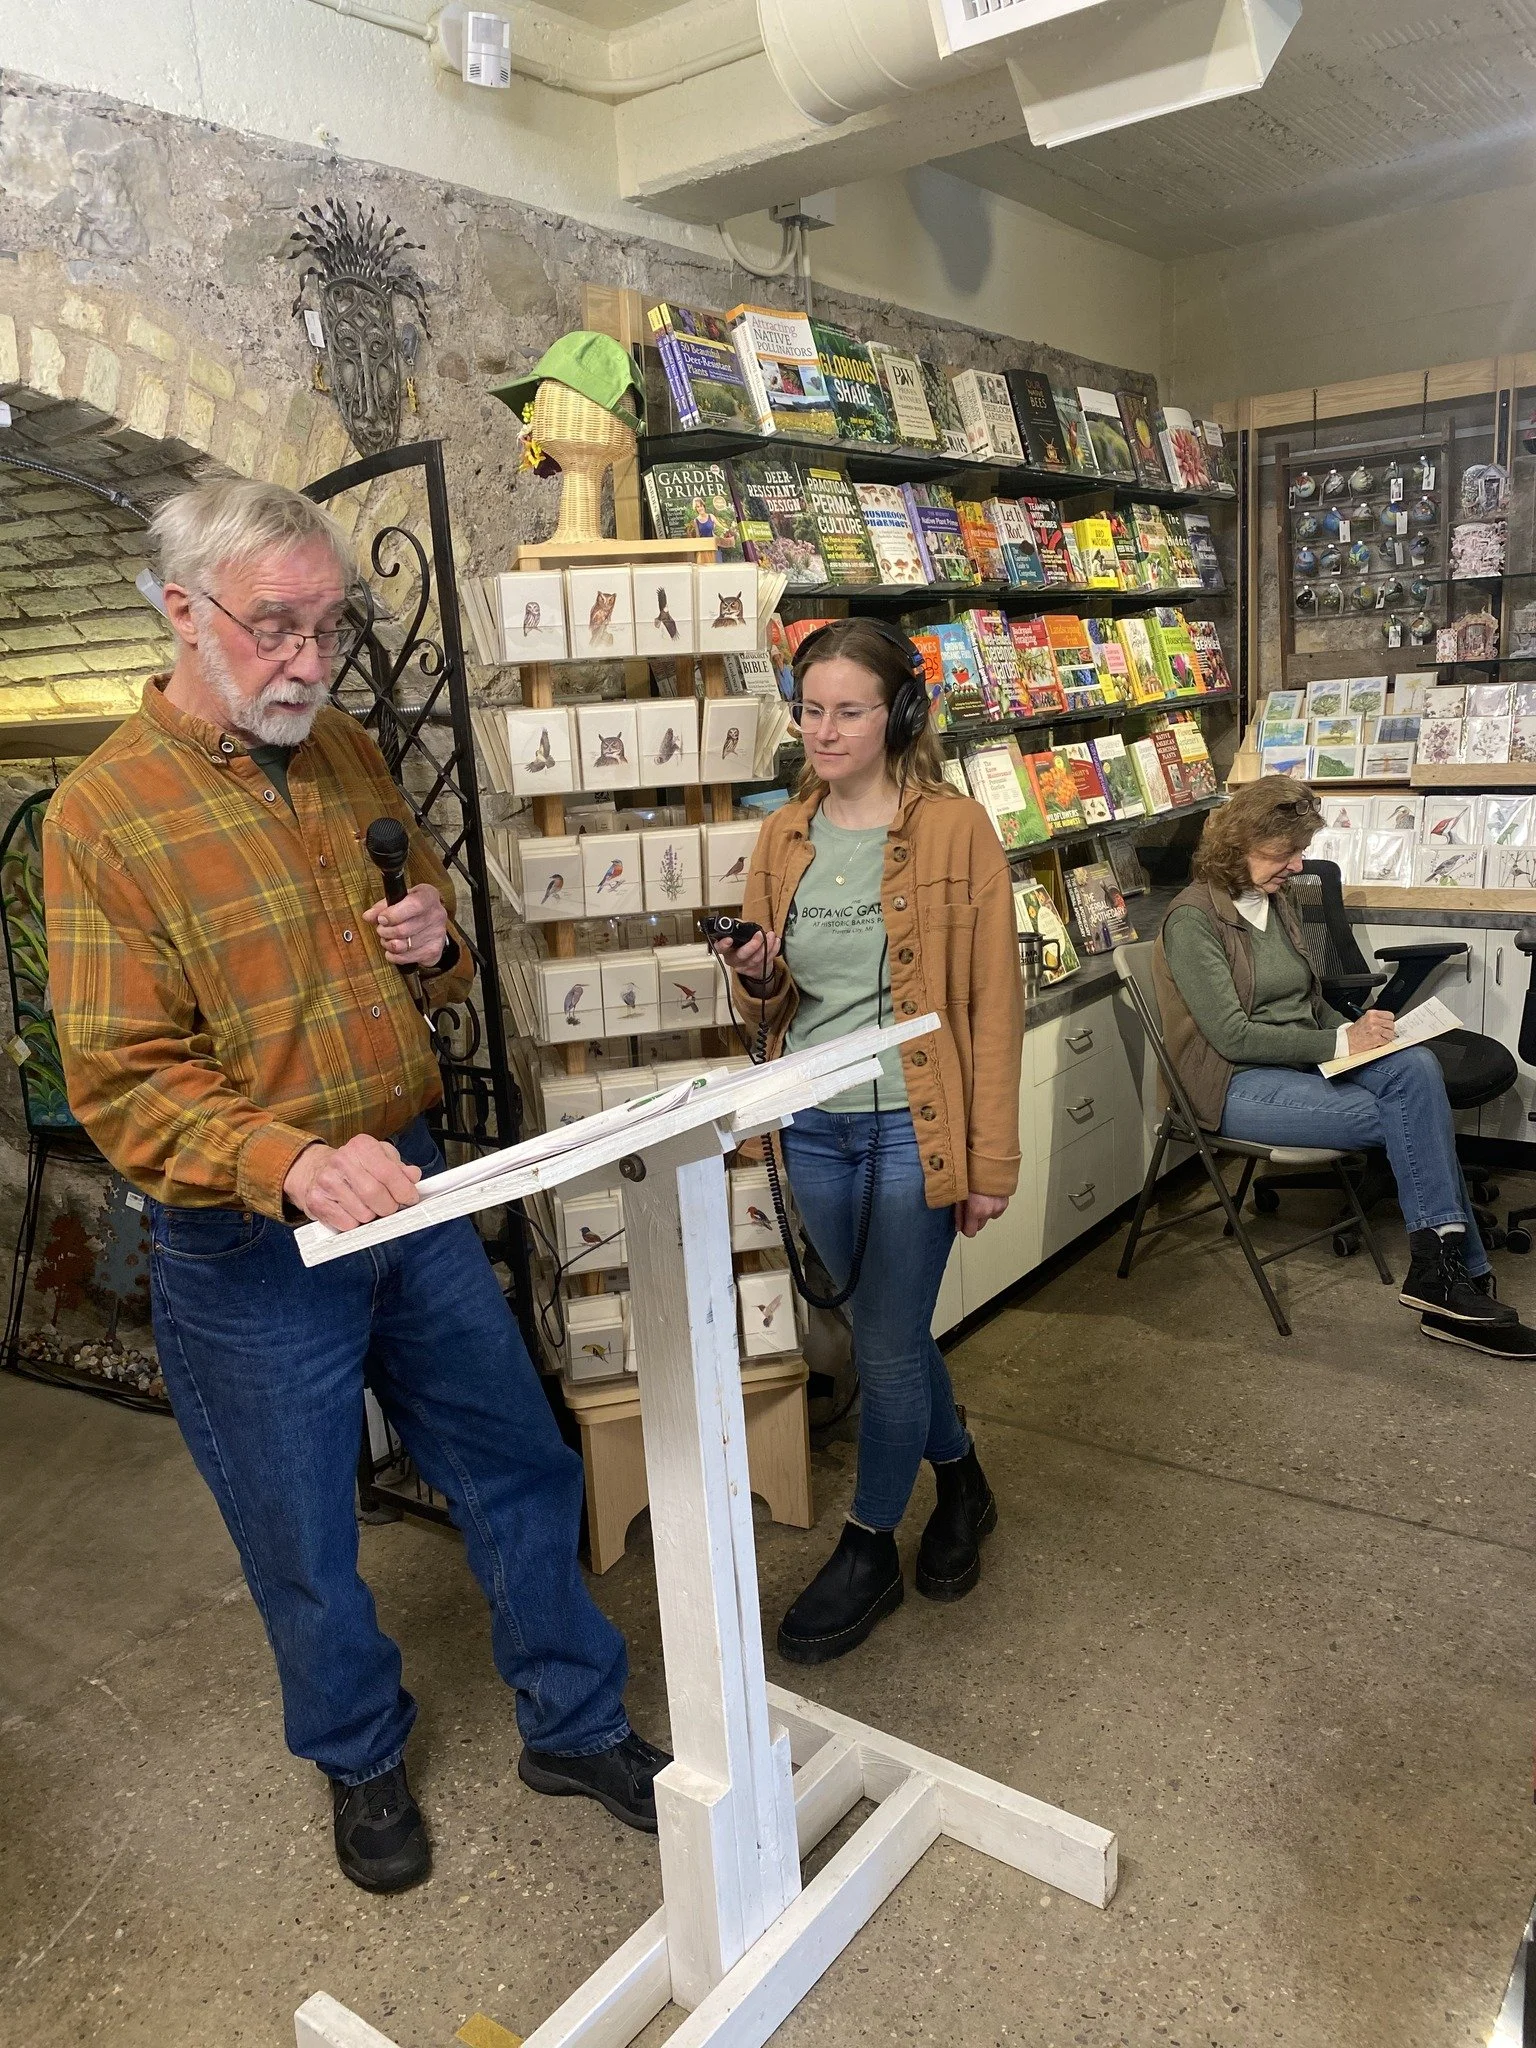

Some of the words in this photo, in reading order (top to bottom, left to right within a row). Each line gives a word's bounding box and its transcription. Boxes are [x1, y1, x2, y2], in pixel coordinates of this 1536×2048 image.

[753, 316, 797, 337] Attracting
[754, 329, 792, 345] NATIVE
[680, 342, 690, 352] 50
[691, 342, 720, 358] Beautiful
[757, 341, 812, 356] POLLINATORS
[684, 353, 732, 372] Deer-Resistant
[819, 352, 877, 384] GLORIOUS
[687, 364, 709, 377] Plants
[834, 378, 875, 407] SHADE
[1030, 397, 1047, 408] BEES
[658, 470, 726, 485] GARDEN
[764, 471, 792, 483] DEER-
[664, 483, 728, 498] PRIMER
[747, 484, 797, 497] RESISTANT
[807, 477, 851, 495] PRACTICAL
[766, 499, 801, 512] DESIGN
[811, 493, 856, 515] PERMA-
[862, 510, 906, 520] MUSHROOM
[1000, 506, 1012, 521] Let
[1166, 514, 1180, 524] The
[817, 516, 864, 534] CULTURE
[1005, 523, 1024, 539] Rot!
[1195, 637, 1220, 650] BERRIES
[742, 661, 769, 673] BIBLE
[1157, 745, 1177, 753] MEDICINAL
[1047, 810, 1079, 821] WILDFLOWERS
[1062, 817, 1081, 826] MIDWEST
[1082, 893, 1095, 902] THE
[802, 906, 853, 919] BOTANIC
[857, 904, 882, 917] GAR
[1086, 901, 1109, 914] HERBAL
[1090, 906, 1125, 923] APOTHECARY
[852, 918, 875, 926] BARNS
